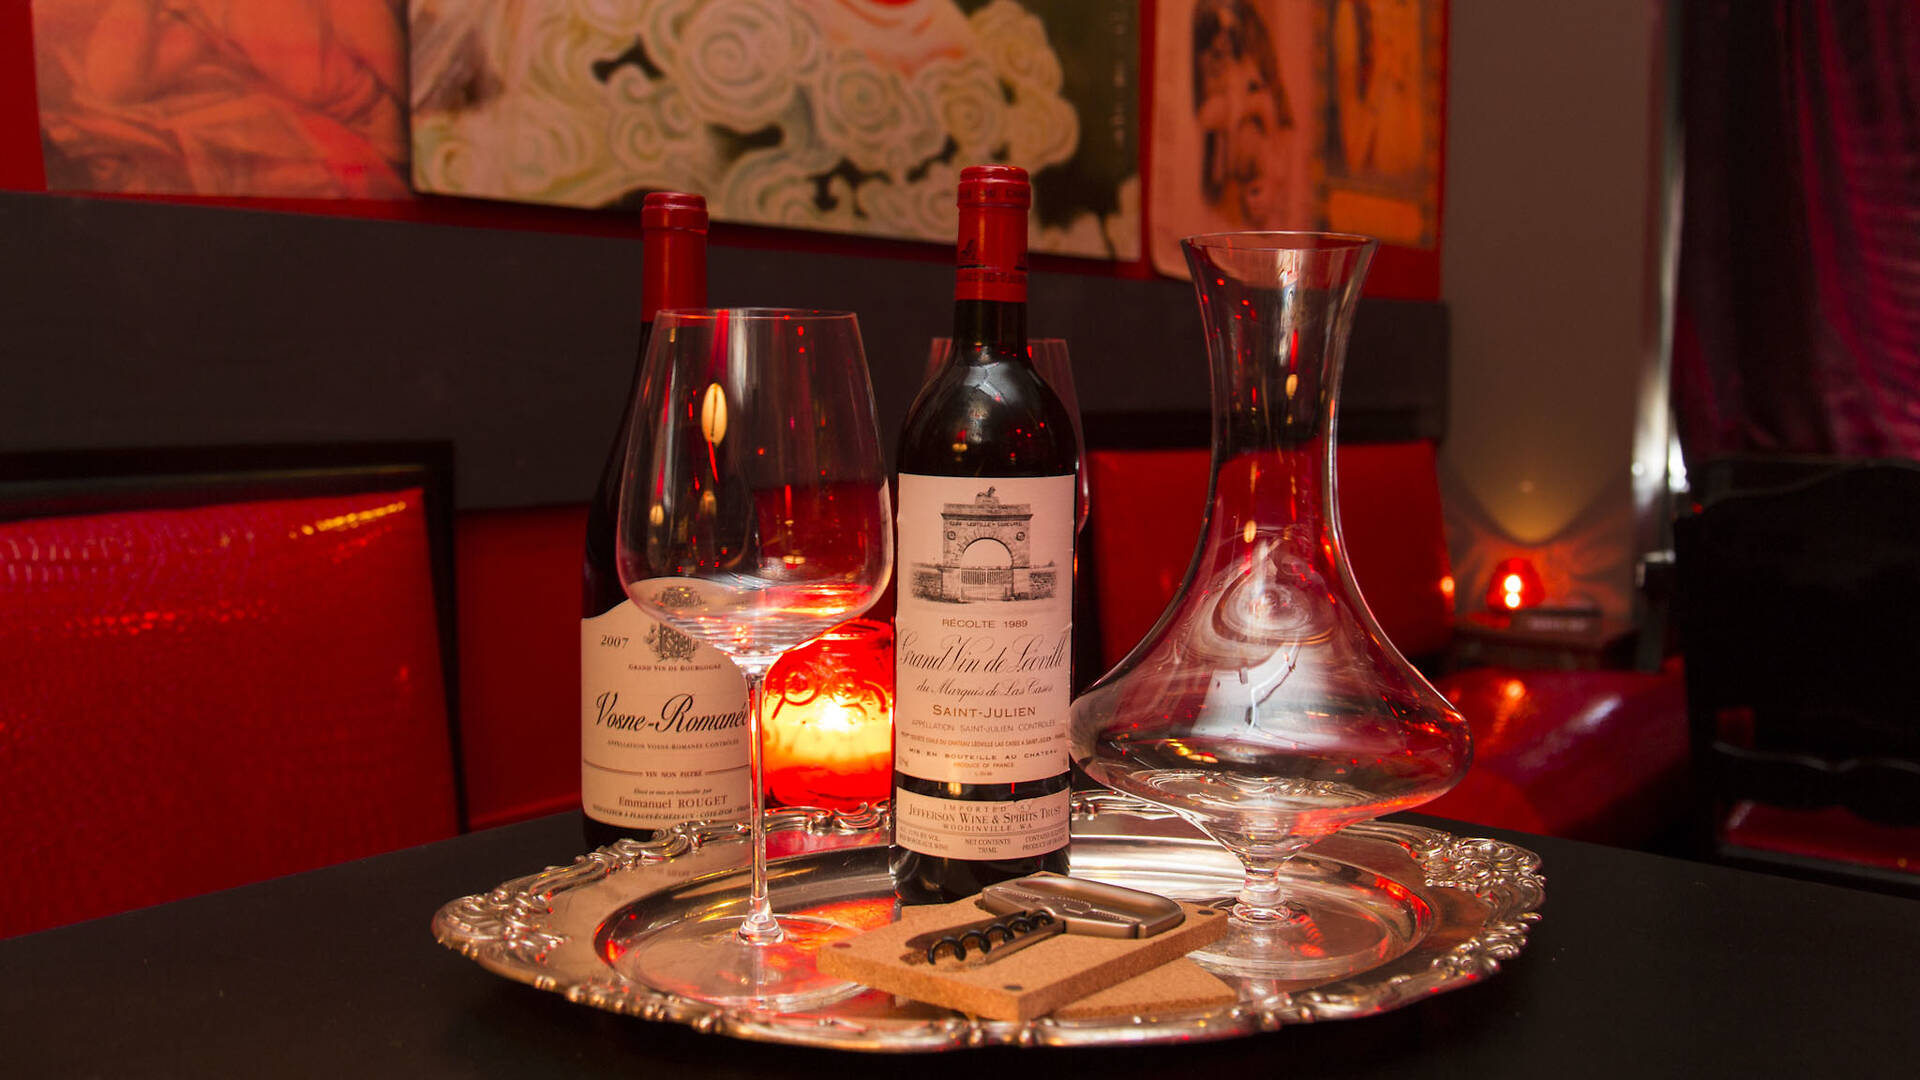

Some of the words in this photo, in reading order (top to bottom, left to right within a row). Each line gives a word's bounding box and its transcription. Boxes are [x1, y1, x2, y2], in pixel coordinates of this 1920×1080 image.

[942, 618, 997, 629] RÉCOLTE
[1003, 619, 1029, 629] 1989
[601, 634, 630, 649] 2007
[899, 628, 953, 671] Grand
[941, 634, 996, 673] Vin
[983, 646, 1008, 673] de
[916, 678, 930, 693] du
[931, 678, 985, 702] Marquis
[985, 682, 1000, 697] de
[1000, 678, 1025, 697] Las
[932, 704, 1036, 719] SAINT-JULIEN
[908, 747, 921, 755] MIS
[945, 753, 997, 761] BOUTEILLE
[619, 795, 672, 809] Emmanuel
[678, 794, 729, 809] ROUGET
[943, 803, 1007, 812] IMPORTED
[909, 803, 956, 822] JEFFERSON
[960, 812, 989, 824] WINE
[991, 814, 999, 825] &
[1003, 811, 1039, 824] SPIRITS
[1040, 806, 1062, 819] TRUST
[1020, 822, 1033, 830] WA
[978, 838, 1011, 846] CONTENTS
